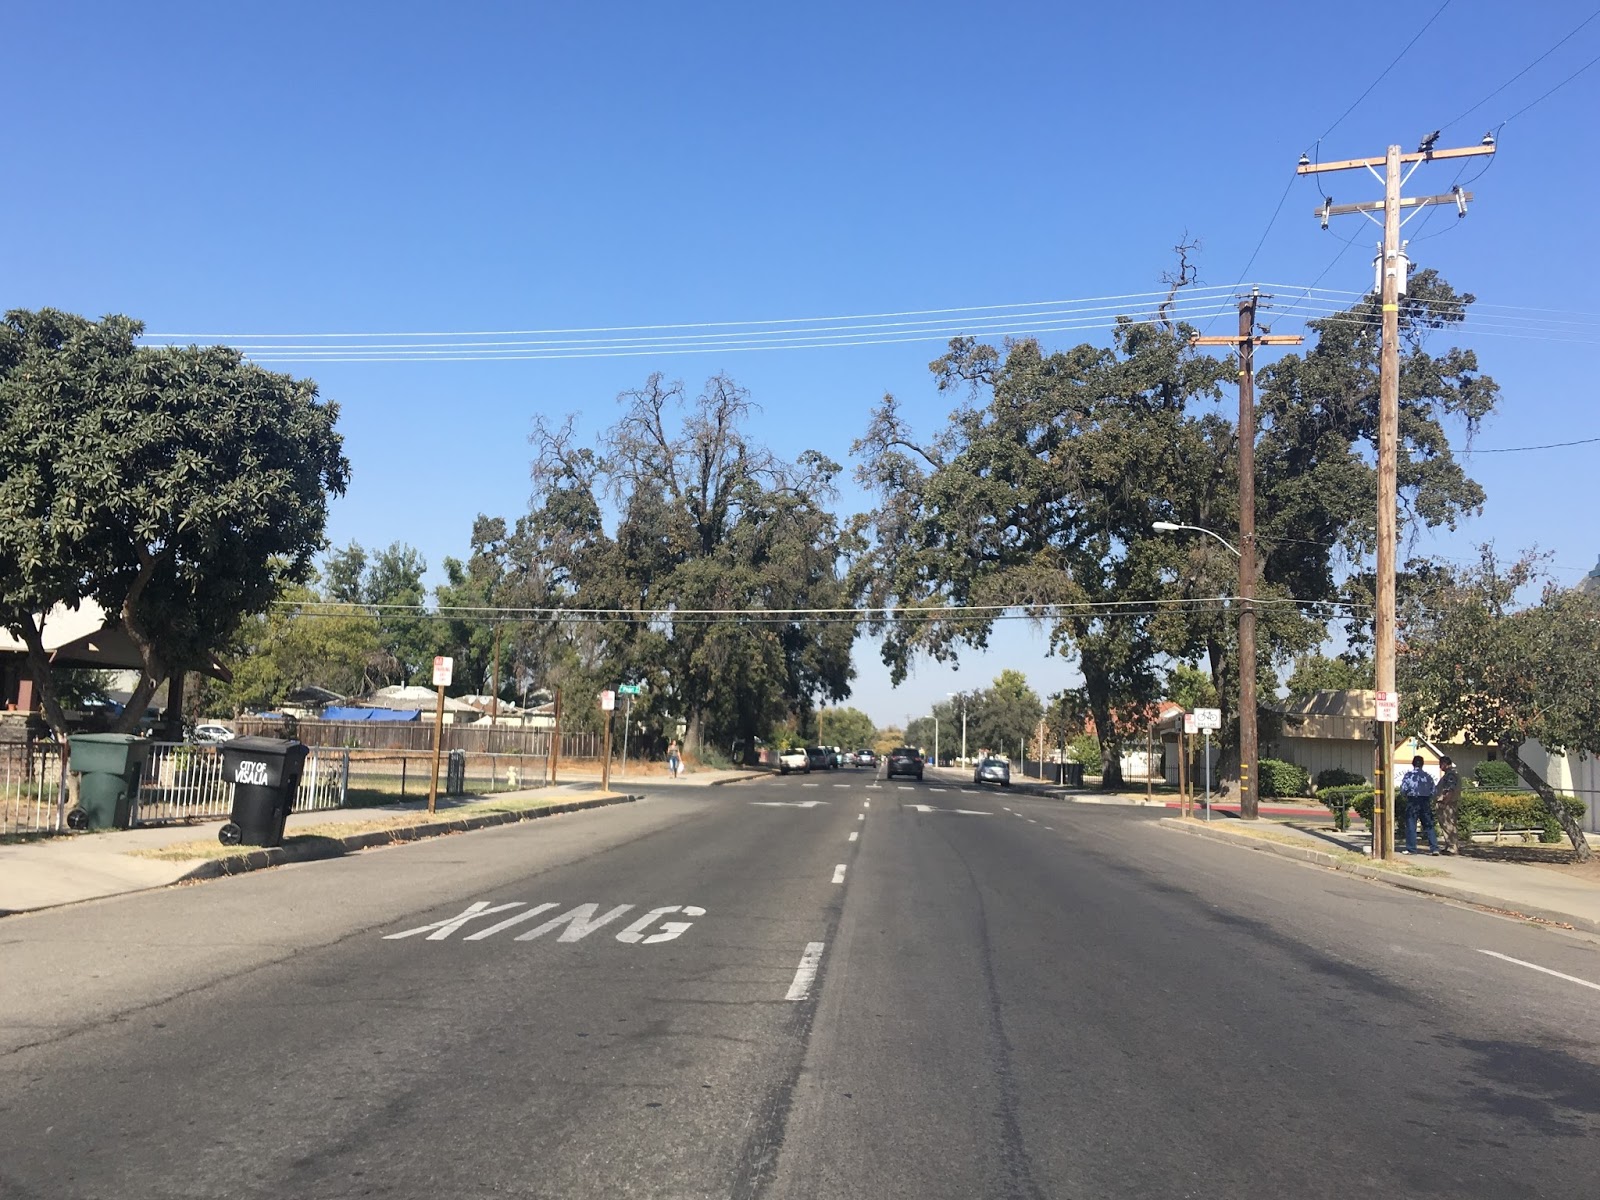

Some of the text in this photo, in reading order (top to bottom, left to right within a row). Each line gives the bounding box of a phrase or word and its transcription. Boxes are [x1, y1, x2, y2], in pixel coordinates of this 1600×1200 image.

[1377, 692, 1386, 700] NO
[240, 761, 267, 772] CITY OF
[235, 769, 268, 786] VISALIA
[381, 901, 707, 944] XING
